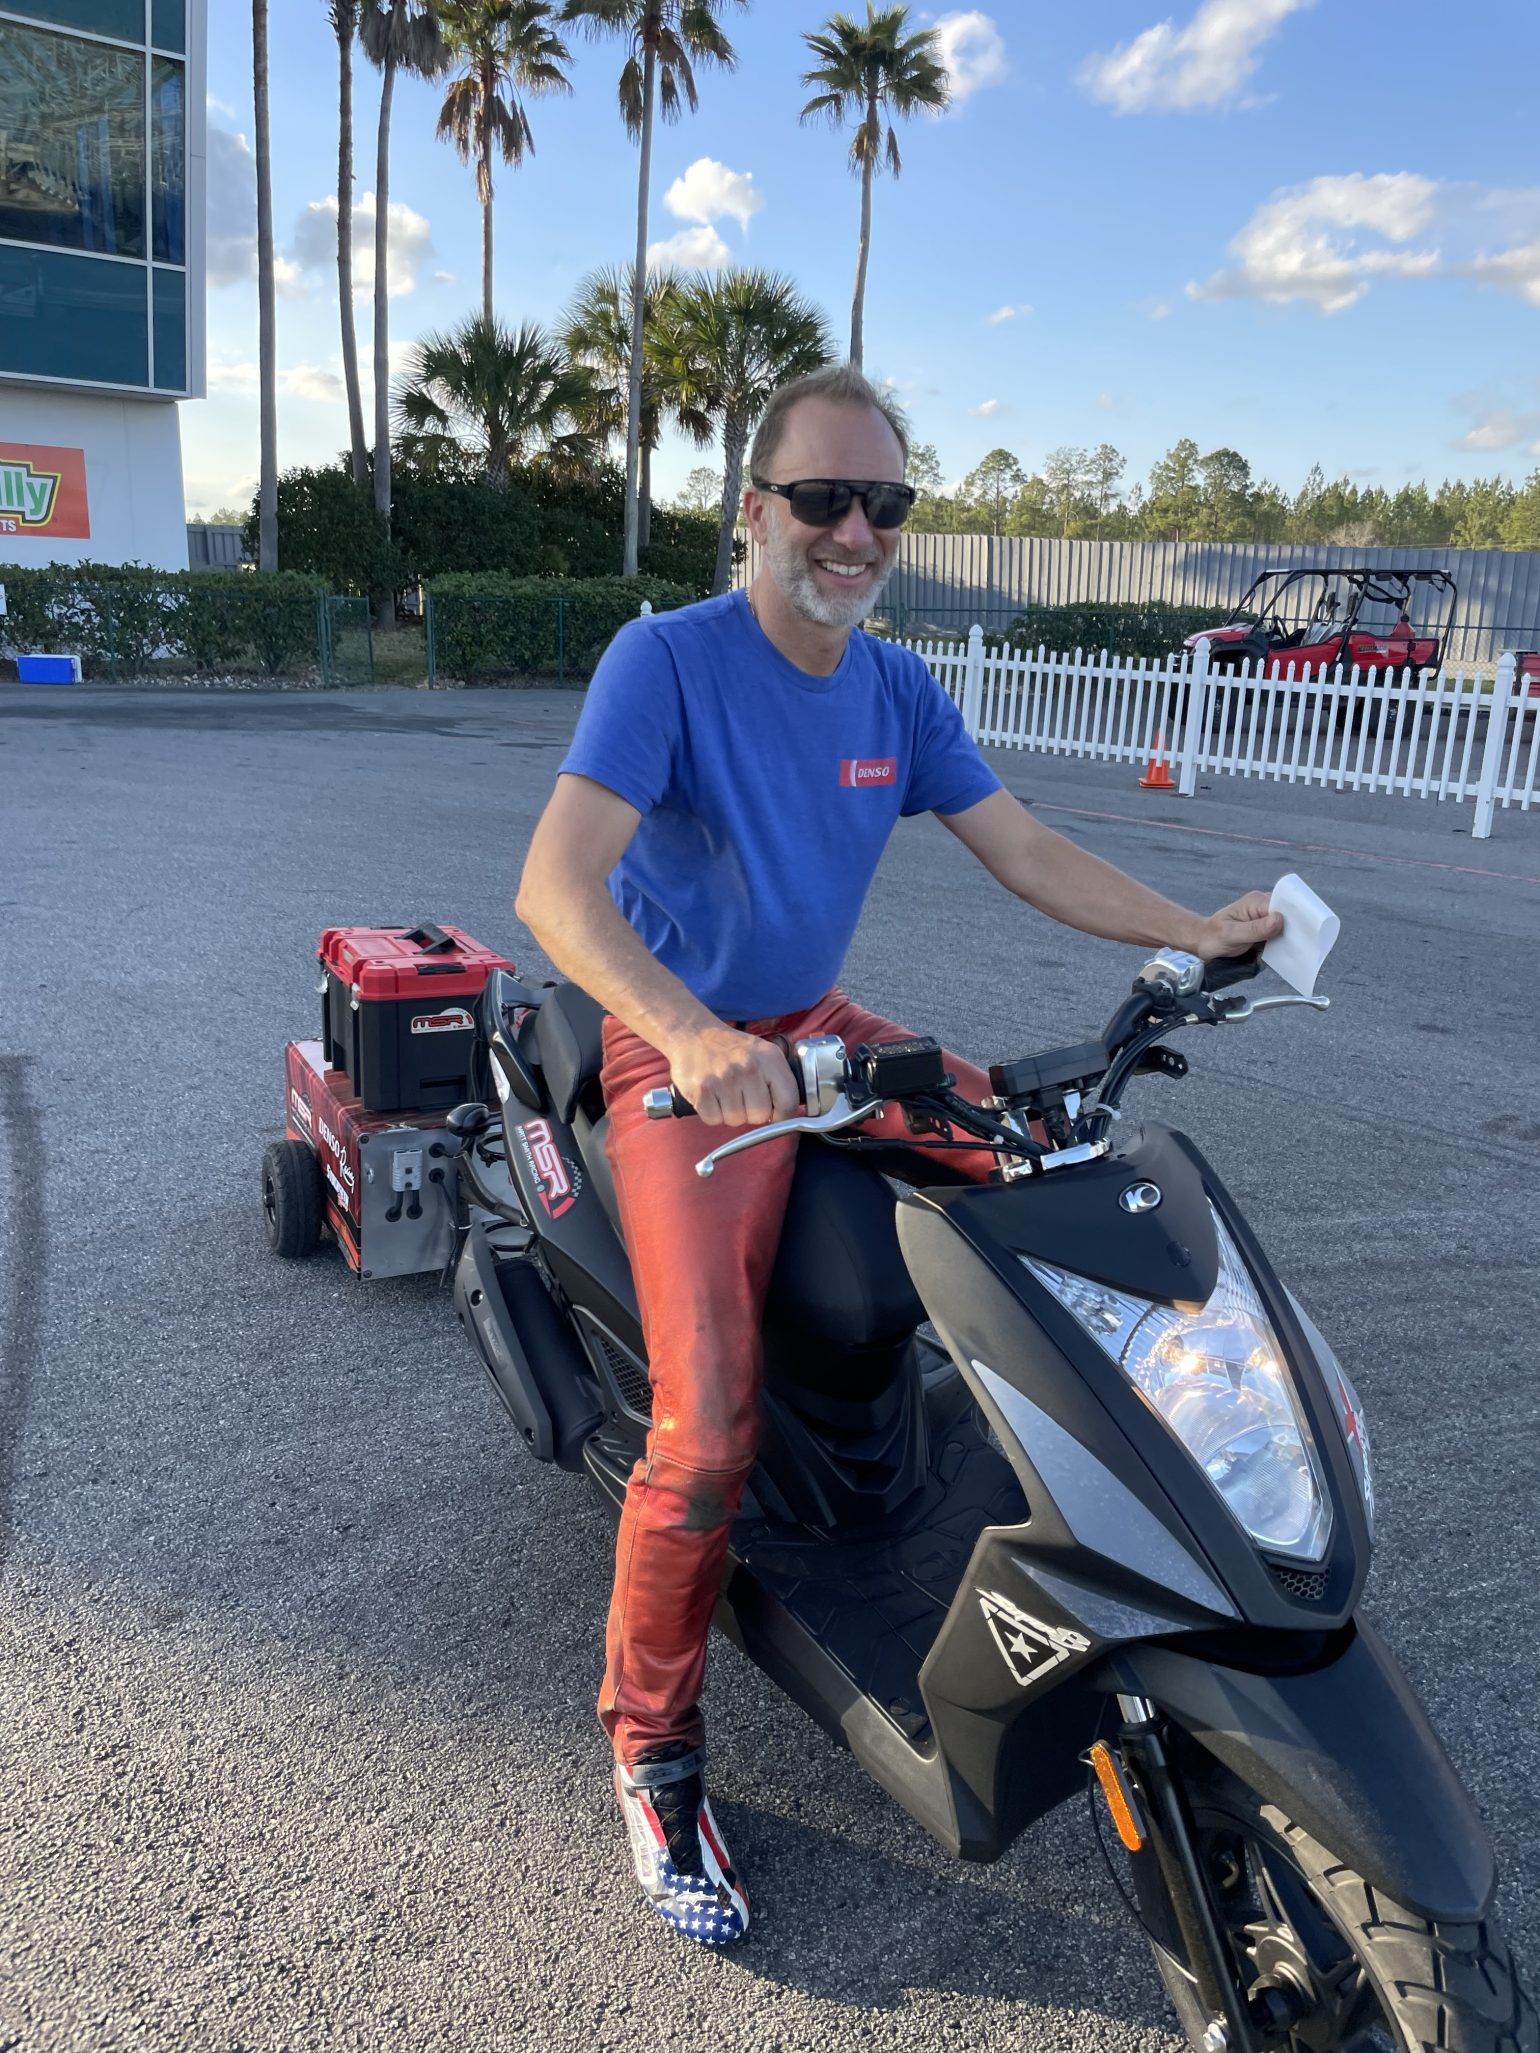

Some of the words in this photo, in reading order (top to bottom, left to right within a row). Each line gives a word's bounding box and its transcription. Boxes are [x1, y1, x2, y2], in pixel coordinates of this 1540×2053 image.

[0, 470, 48, 516] lly
[857, 766, 890, 778] DENSO
[318, 1116, 340, 1158] DENSO
[516, 1125, 527, 1141] MATT
[522, 1141, 533, 1160] SMITH
[528, 1160, 541, 1184] RACING
[524, 1117, 571, 1201] MSR
